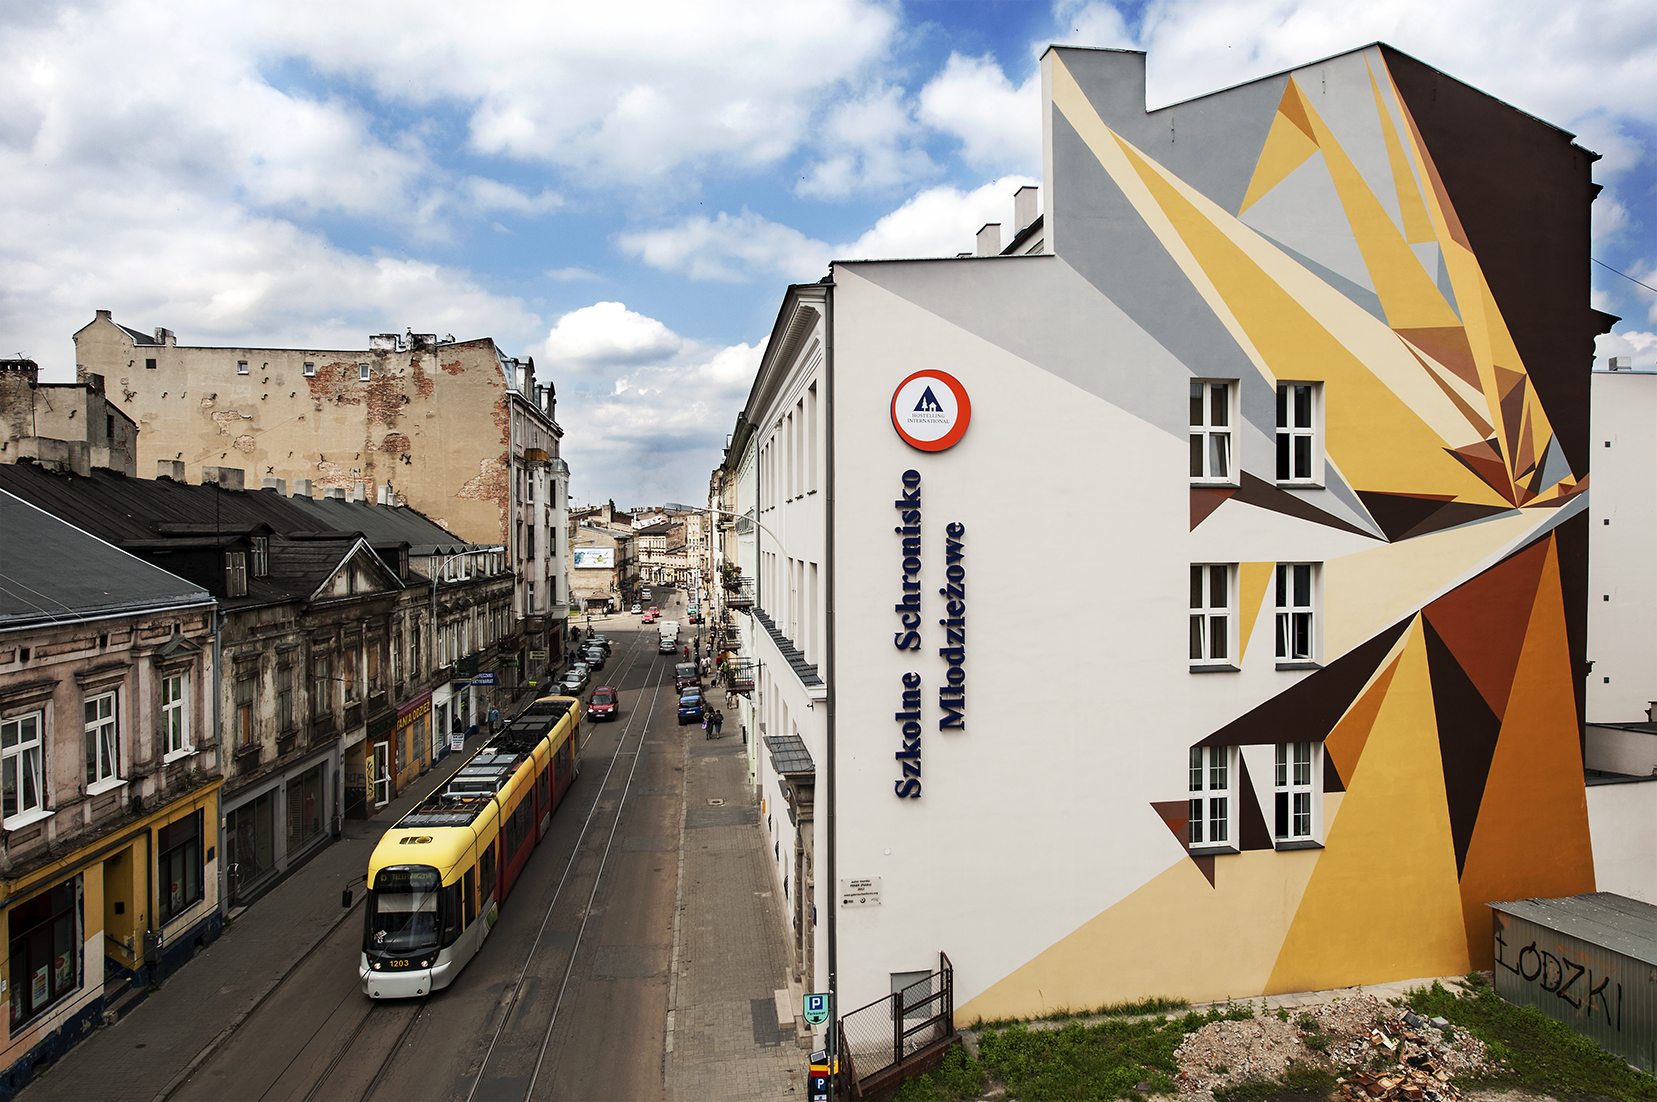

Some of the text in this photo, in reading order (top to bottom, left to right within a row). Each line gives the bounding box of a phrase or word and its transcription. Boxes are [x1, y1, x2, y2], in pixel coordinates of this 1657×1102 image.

[894, 468, 922, 799] Szkolne Schronisko
[939, 521, 965, 732] Młodzieżowe
[389, 959, 409, 968] 1203
[812, 997, 821, 1009] P
[1494, 930, 1622, 1032] ŁÓDZKI
